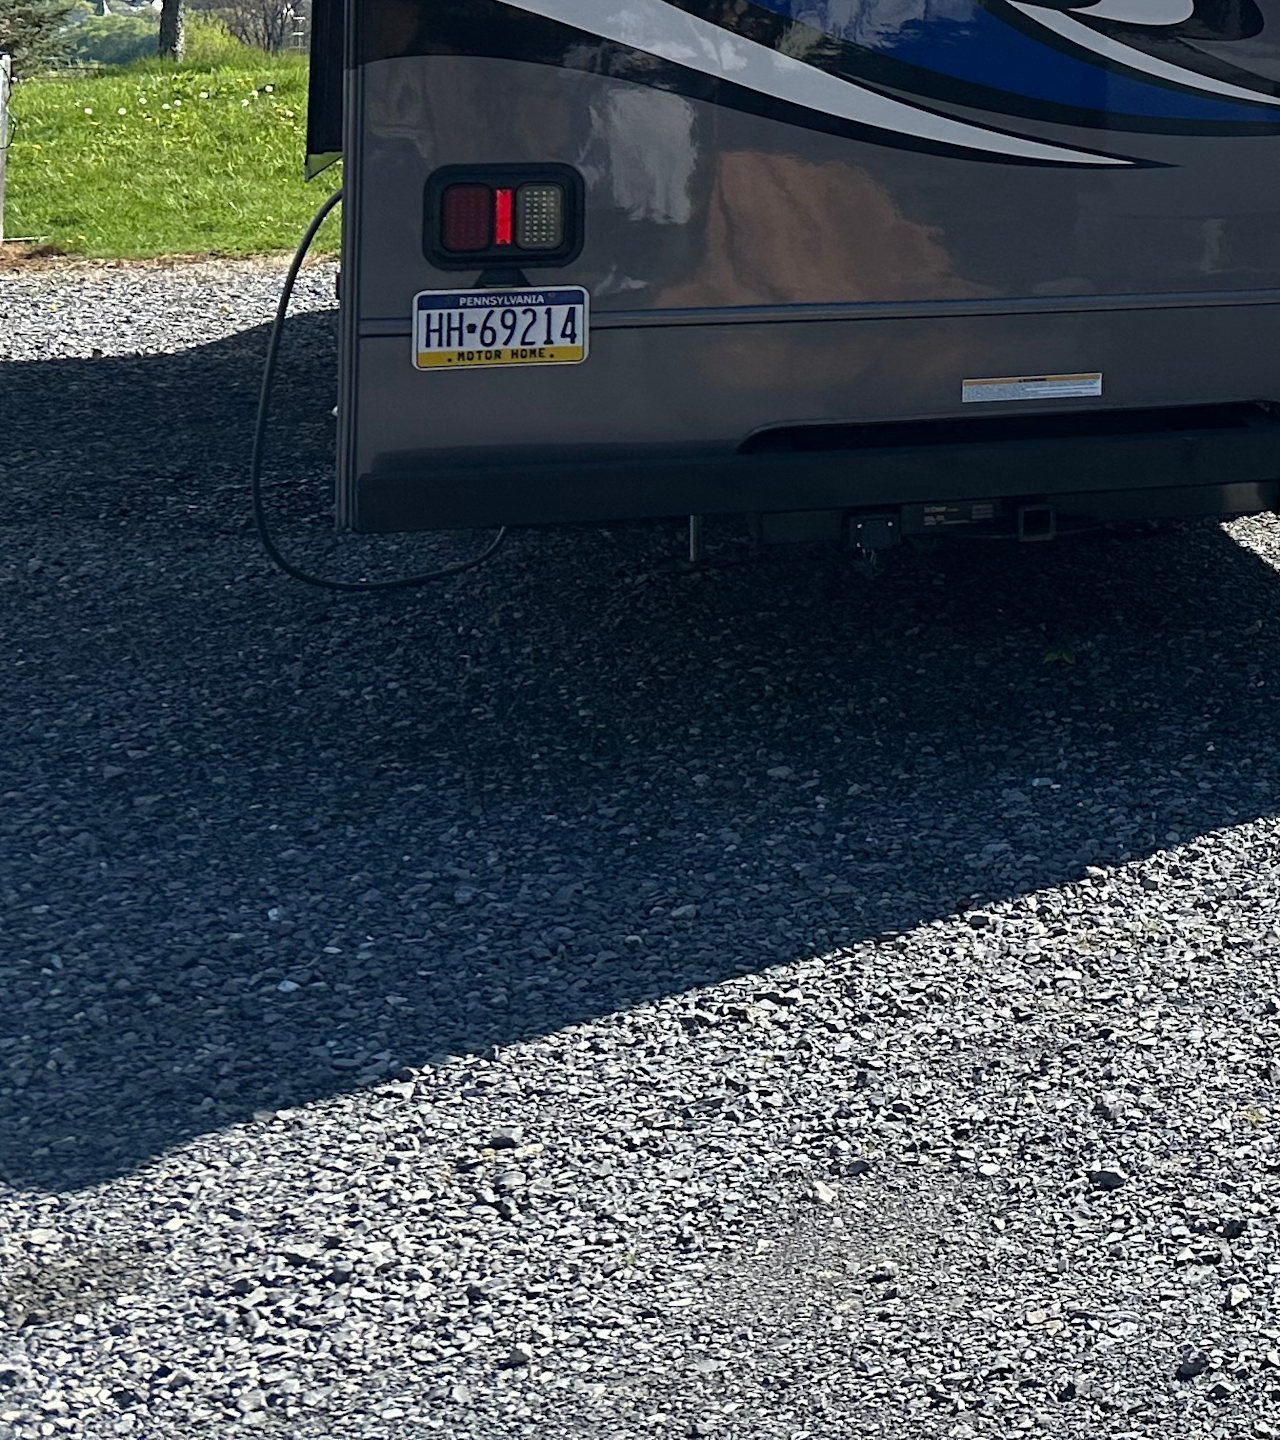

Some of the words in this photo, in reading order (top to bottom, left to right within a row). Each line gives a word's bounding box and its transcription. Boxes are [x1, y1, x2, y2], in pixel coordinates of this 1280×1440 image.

[459, 294, 545, 307] PENNSYLVANIA
[457, 350, 502, 362] MOTOR
[511, 348, 546, 360] HOME
